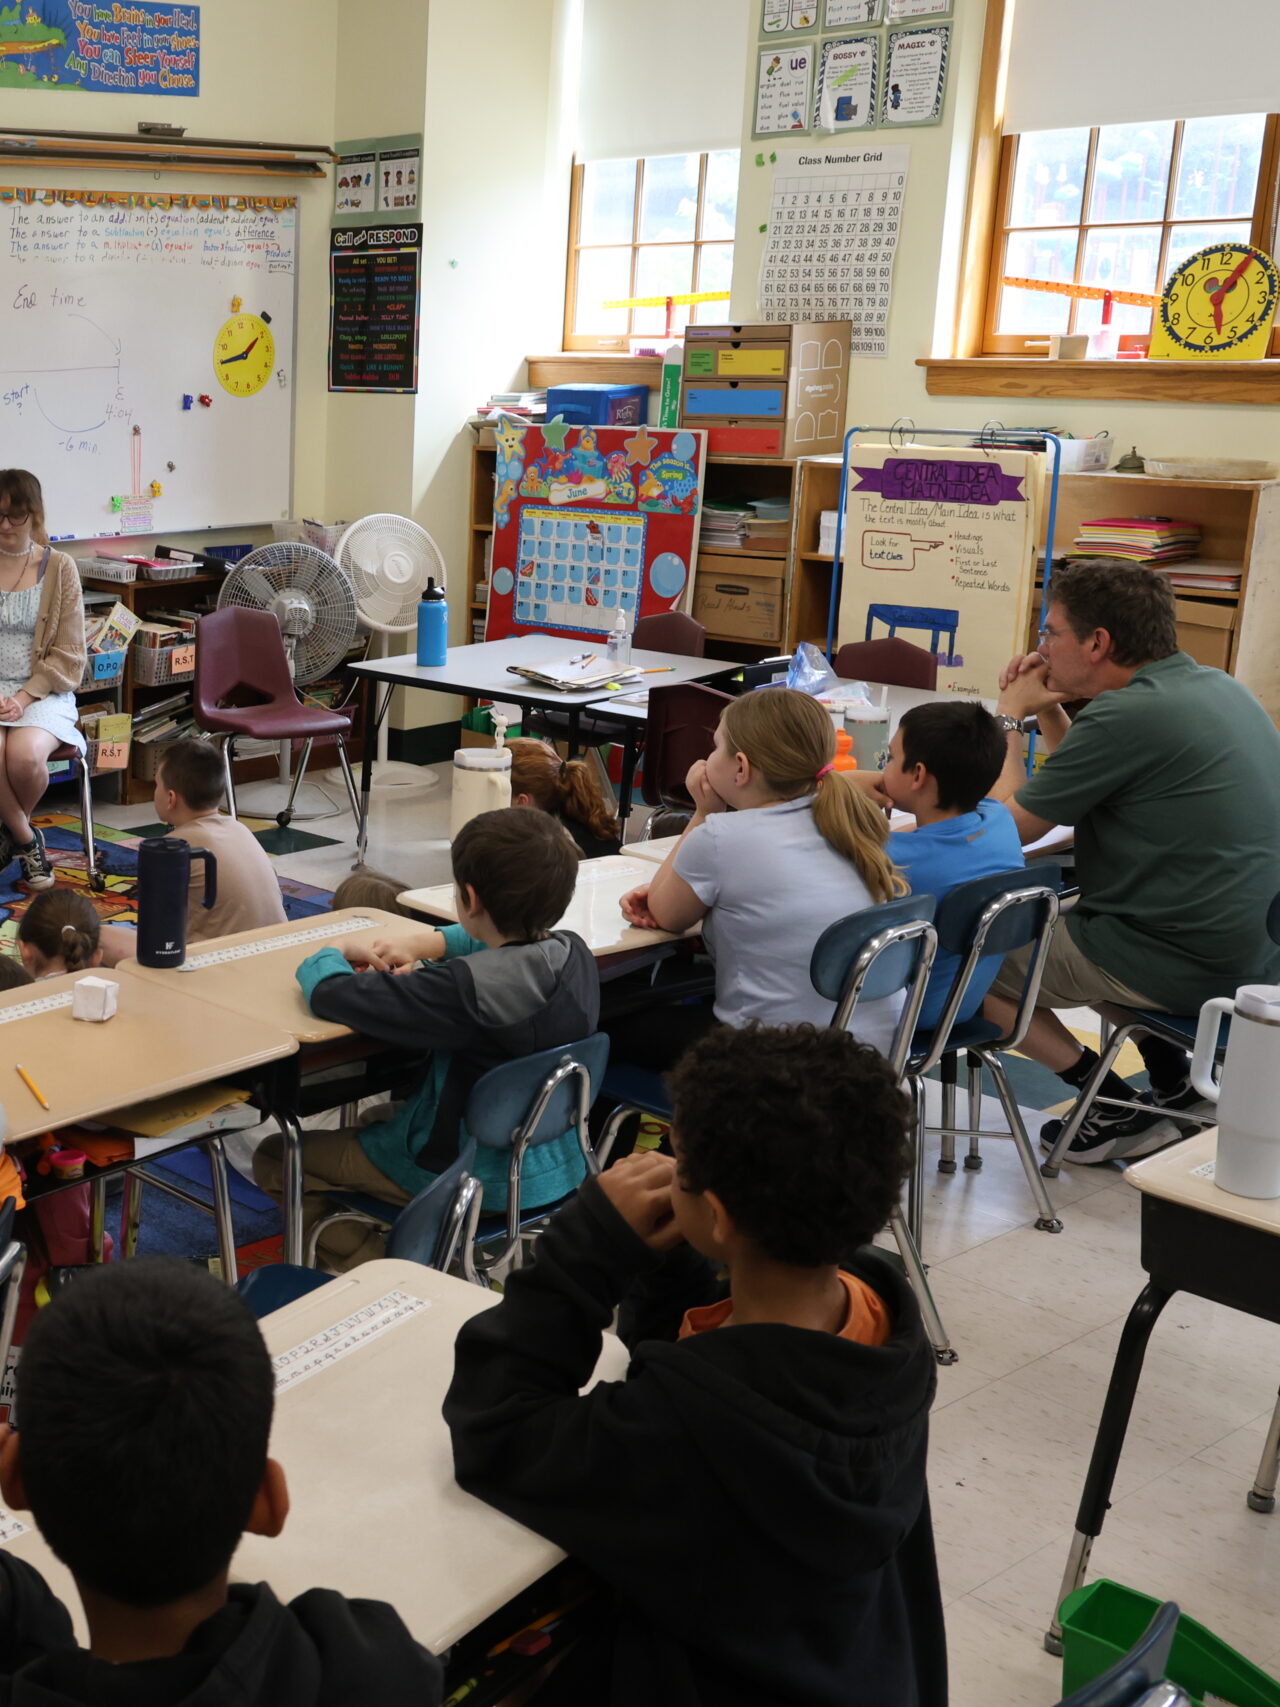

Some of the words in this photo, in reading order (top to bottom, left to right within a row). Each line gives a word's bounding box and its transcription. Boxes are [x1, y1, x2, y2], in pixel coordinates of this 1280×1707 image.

[68, 0, 91, 19] You
[93, 4, 112, 22] have
[112, 3, 145, 25] Brains
[154, 12, 172, 28] your
[76, 20, 100, 41] You
[101, 24, 120, 44] have
[120, 26, 142, 47] Feet
[143, 33, 152, 48] in
[153, 34, 171, 48] your
[897, 41, 926, 50] MAGIC
[77, 38, 101, 59] You
[102, 49, 121, 65] can
[124, 46, 157, 66] Steer
[157, 50, 195, 70] Yourself
[833, 52, 857, 61] BOSSY
[65, 50, 88, 77] Any
[90, 62, 136, 87] Direction
[138, 68, 157, 87] you
[790, 57, 807, 71] ue
[798, 155, 822, 166] Class
[824, 154, 861, 165] Number
[863, 152, 883, 162] Grid
[892, 191, 902, 201] 10
[10, 206, 30, 225] The
[37, 214, 74, 224] answer
[888, 206, 899, 217] 20
[10, 227, 27, 239] The
[886, 222, 897, 232] 30
[335, 232, 353, 246] Call
[368, 229, 418, 244] RESPOND
[884, 237, 896, 248] 40
[880, 252, 892, 262] 50
[1220, 252, 1233, 265] 12
[1201, 258, 1211, 271] 11
[879, 267, 890, 277] 60
[1181, 273, 1195, 287] 10
[13, 284, 36, 309] End
[50, 288, 87, 307] time
[1170, 293, 1179, 305] 9
[1257, 291, 1268, 304] 3
[1246, 312, 1256, 324] 4
[105, 404, 133, 425] 4:04
[662, 458, 684, 468] season
[661, 470, 684, 480] Spring
[894, 462, 948, 482] CENTRAL
[955, 464, 999, 484] IDEA
[566, 486, 588, 500] June
[901, 482, 949, 499] MAIN
[951, 484, 991, 502] IDEA
[860, 498, 877, 512] The
[880, 499, 906, 515] Central
[955, 505, 979, 519] Idea
[981, 511, 990, 520] is
[865, 515, 877, 523] the
[879, 515, 894, 526] text
[906, 518, 926, 529] mostly
[871, 536, 887, 547] Look
[954, 531, 983, 542] Headings
[870, 551, 886, 560] text
[956, 545, 984, 555] Visuals
[955, 558, 971, 567] First
[959, 567, 988, 576] Sentence
[955, 576, 986, 591] Repeated
[987, 581, 1010, 592] Words
[175, 655, 194, 666] R,S,T
[952, 681, 980, 694] Examples
[101, 748, 122, 758] R,S,T
